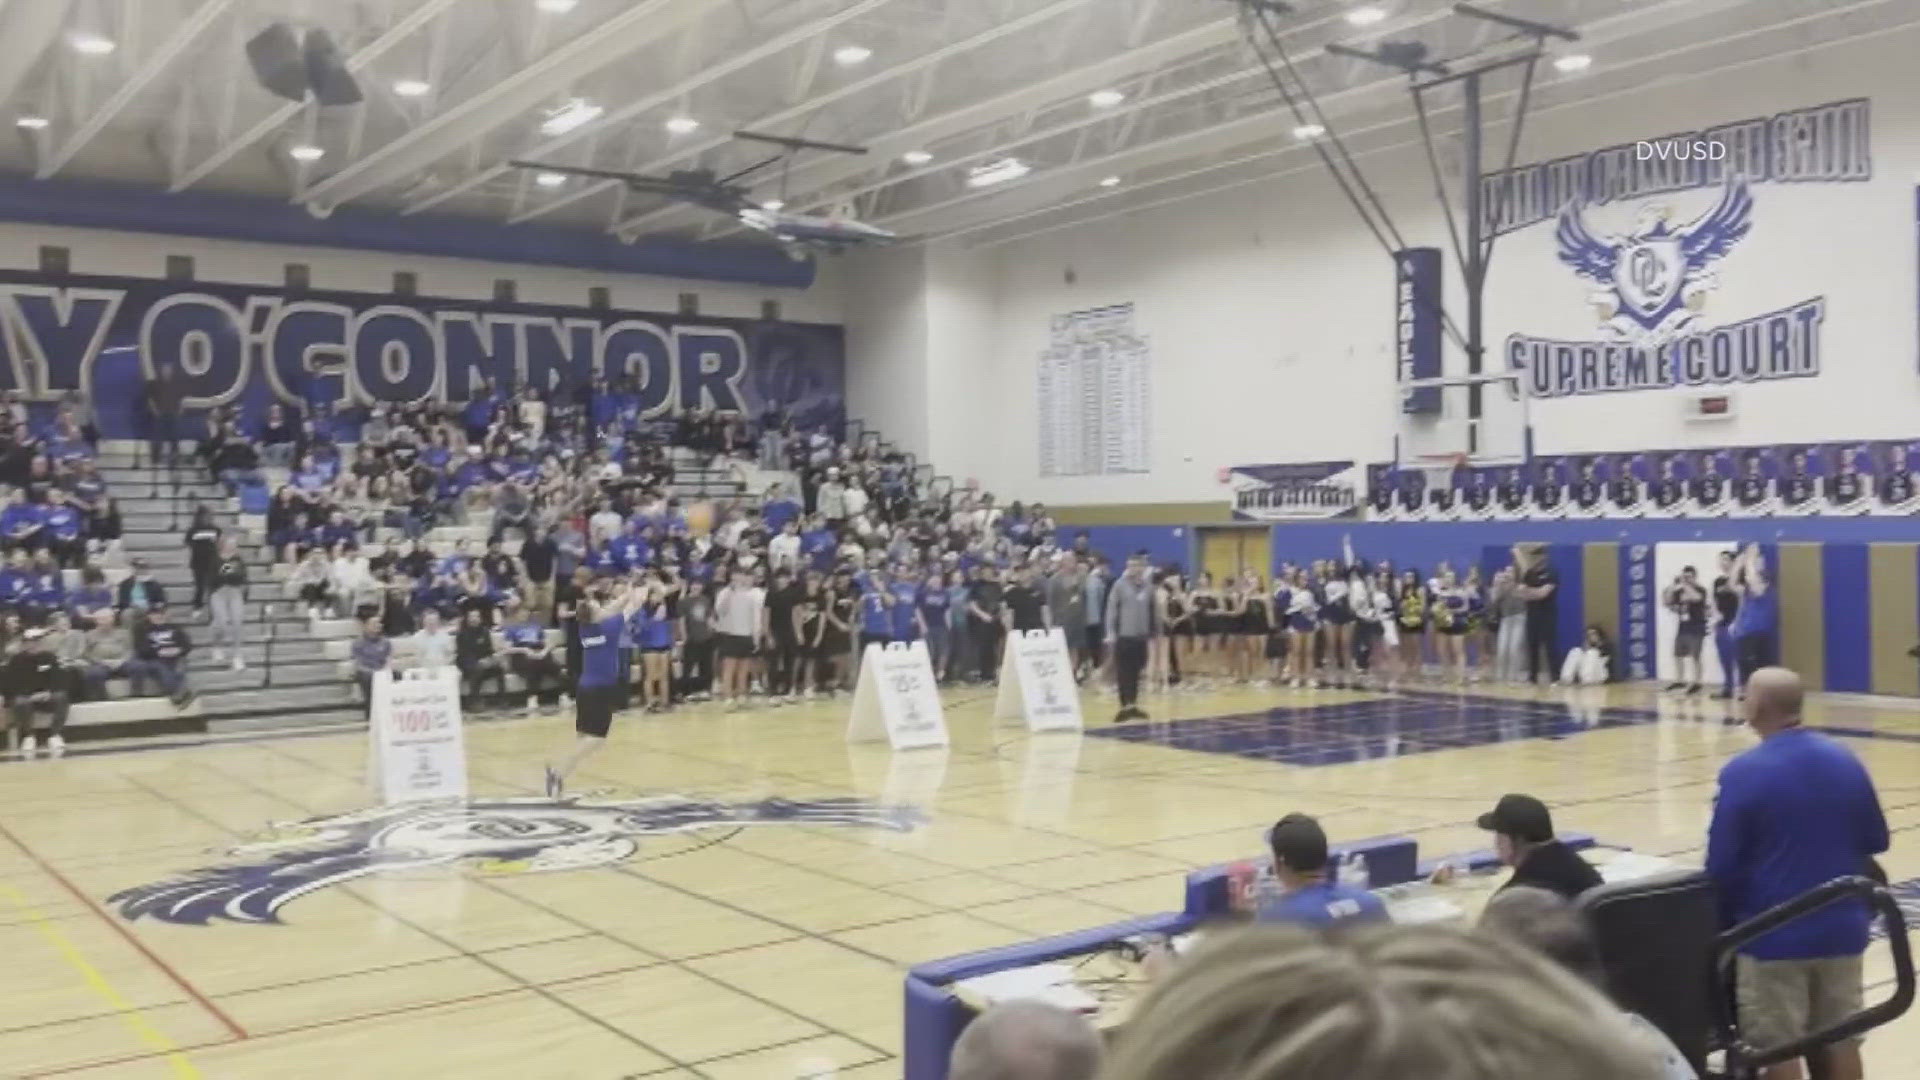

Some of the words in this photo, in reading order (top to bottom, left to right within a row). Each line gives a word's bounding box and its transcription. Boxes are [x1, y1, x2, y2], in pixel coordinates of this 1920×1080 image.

[138, 292, 750, 421] O'CONNOR
[1506, 332, 1676, 398] SUPREME
[1684, 296, 1824, 385] COURT
